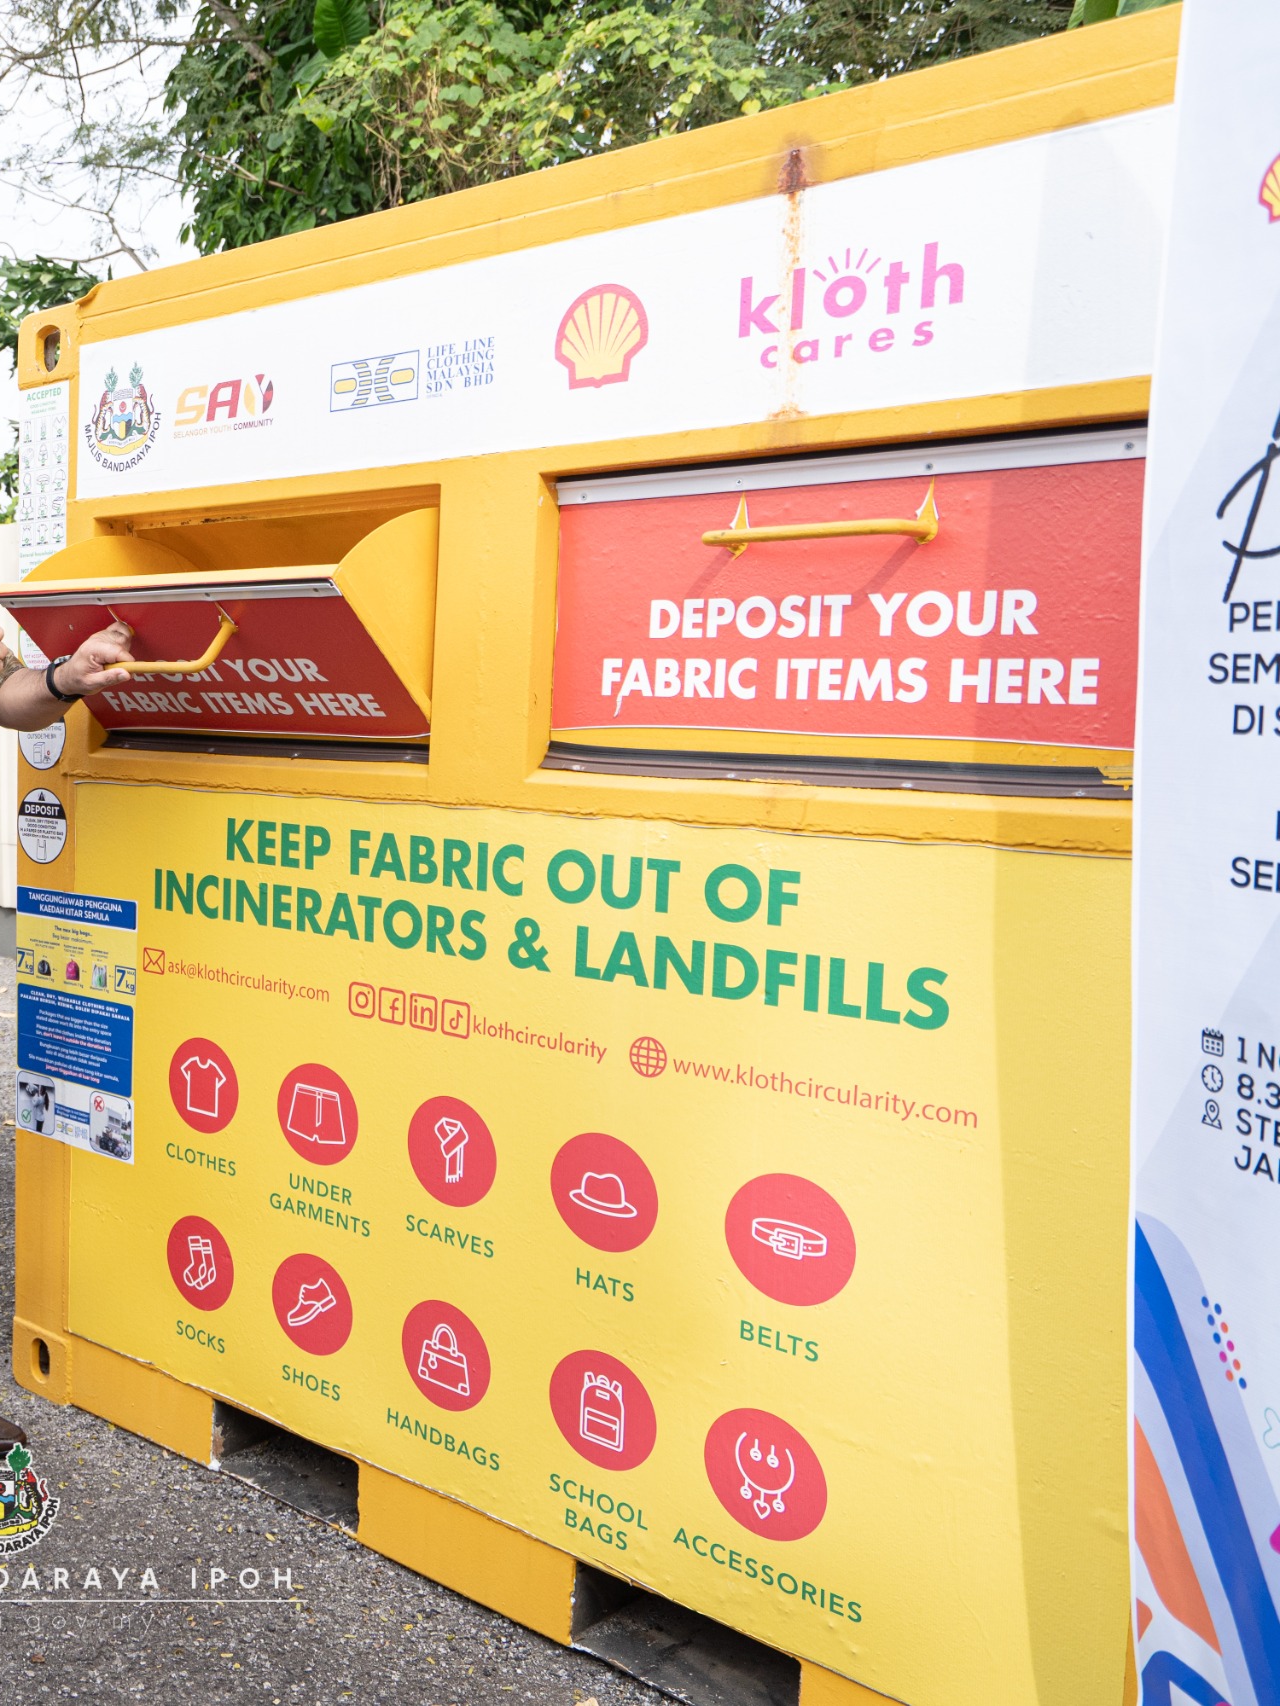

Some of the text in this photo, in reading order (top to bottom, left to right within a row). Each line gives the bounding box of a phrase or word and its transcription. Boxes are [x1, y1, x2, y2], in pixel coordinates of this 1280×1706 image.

[738, 242, 965, 338] kloth
[427, 349, 494, 370] CLOTHING
[428, 336, 495, 358] LIFE LINE
[760, 321, 934, 369] cares
[426, 373, 493, 393] SDN BHD
[427, 362, 494, 381] MALAYSIA
[27, 387, 61, 401] ACCEPTED
[85, 412, 161, 472] MAJLIS BANDARAYA IPOH
[173, 418, 274, 439] SELANGOR YOUTH COMMUNITY
[649, 589, 1039, 639] DEPOSIT YOUR
[1229, 601, 1280, 632] PE
[222, 658, 328, 683] YOUR
[601, 657, 1099, 705] FABRIC ITEMS HERE
[103, 692, 386, 717] FABRIC ITEMS HERE
[1233, 705, 1264, 735] DI
[24, 804, 59, 816] DEPOSIT
[226, 817, 801, 927] KEEP FABRIC OUT OF
[1230, 856, 1280, 893] SE
[40, 904, 110, 921] KAEDAH KITAR SEMULA
[85, 900, 122, 912] PENGGUNA
[17, 950, 25, 968] 7
[154, 868, 950, 1031] INCINERATORS & LANDFILLS
[25, 961, 33, 973] kg
[117, 969, 126, 987] 7
[168, 958, 330, 1002] ask@klothcircularity.com
[30, 990, 45, 998] CLEAN,
[58, 995, 80, 1005] WEARABLE
[82, 1001, 104, 1010] CLOTHING
[126, 980, 135, 992] kg
[20, 993, 39, 1001] PAKAIAN
[91, 1009, 110, 1017] DIPAKAI
[473, 1014, 607, 1064] klothcircularity
[1237, 1036, 1247, 1064] 1
[673, 1058, 978, 1129] www.klothcircularity.com
[166, 1142, 236, 1177] CLOTHES
[289, 1172, 352, 1206] UNDER
[270, 1193, 371, 1238] GARMENTS
[406, 1214, 494, 1258] SCARVES
[575, 1267, 635, 1302] HATS
[176, 1320, 225, 1354] SOCKS
[739, 1319, 819, 1363] BELTS
[282, 1365, 340, 1401] SHOES
[386, 1407, 501, 1472] HANDBAGS
[549, 1474, 649, 1531] SCHOOL
[564, 1508, 628, 1552] BAGS
[672, 1528, 863, 1623] ACCESSORIES
